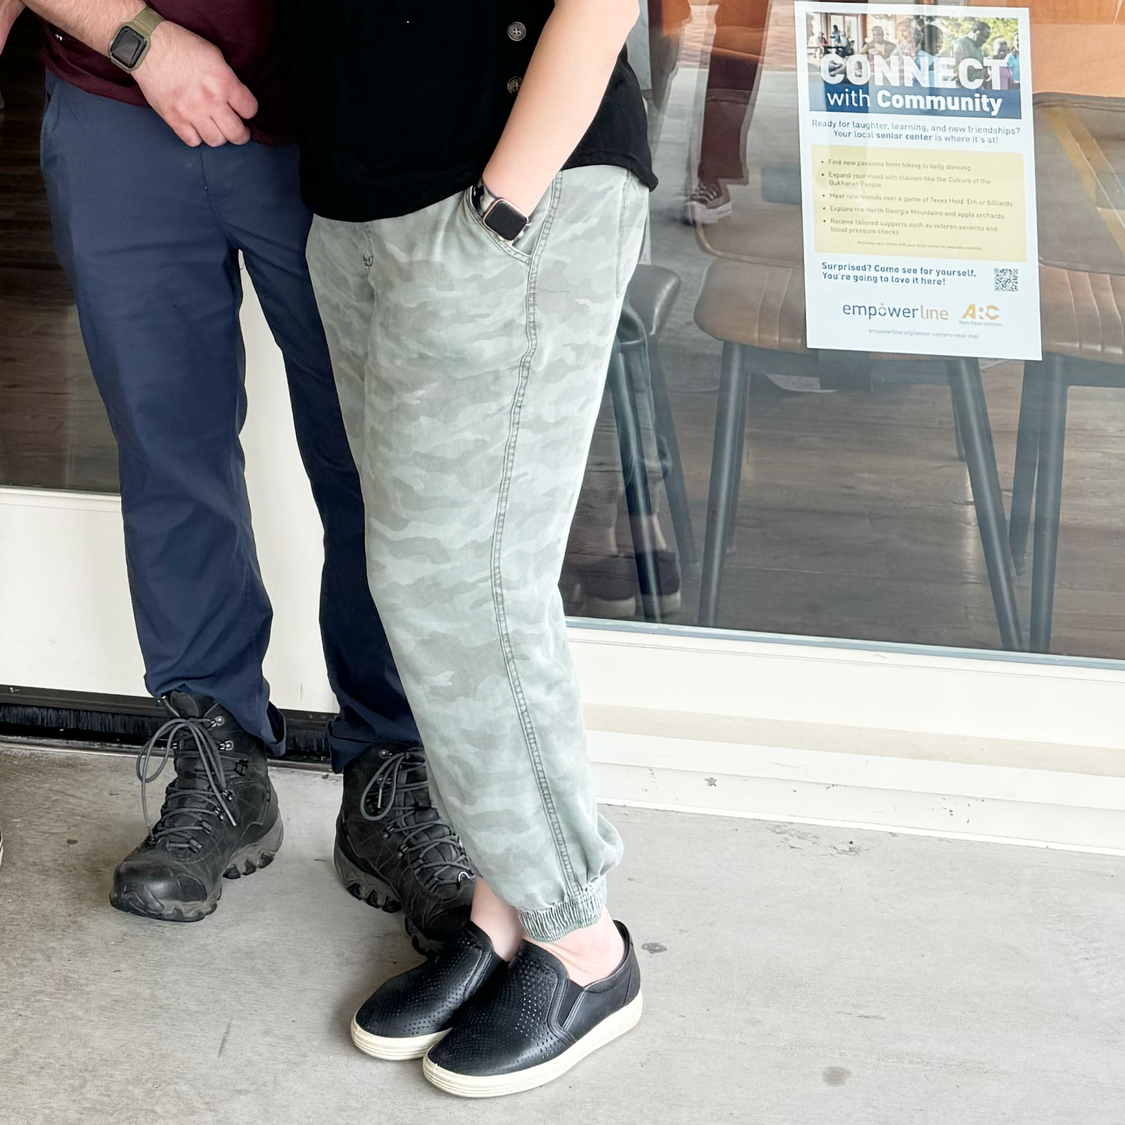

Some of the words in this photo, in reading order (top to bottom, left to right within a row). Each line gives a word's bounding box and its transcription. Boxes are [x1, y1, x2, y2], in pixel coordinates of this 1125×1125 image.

[820, 54, 1009, 91] CONNECT
[826, 88, 870, 107] with
[877, 89, 1003, 116] Community
[812, 119, 836, 129] Ready
[838, 119, 850, 128] for
[852, 120, 889, 130] laughter,
[891, 122, 928, 133] learning,
[931, 124, 946, 132] and
[968, 125, 1020, 136] friendships?
[833, 129, 852, 138] Your
[854, 130, 874, 139] local
[876, 132, 902, 140] senior
[905, 133, 932, 141] center
[944, 134, 970, 142] where
[972, 135, 985, 143] it's
[987, 136, 998, 144] at!
[821, 261, 872, 272] Surprised?
[874, 264, 899, 273] Come
[920, 267, 933, 275] for
[935, 268, 976, 277] yourself.
[822, 272, 851, 280] You're
[853, 274, 878, 284] going
[880, 275, 889, 283] to
[891, 275, 910, 284] love
[912, 276, 919, 284] it
[921, 276, 946, 286] here!
[842, 303, 949, 320] empowerline
